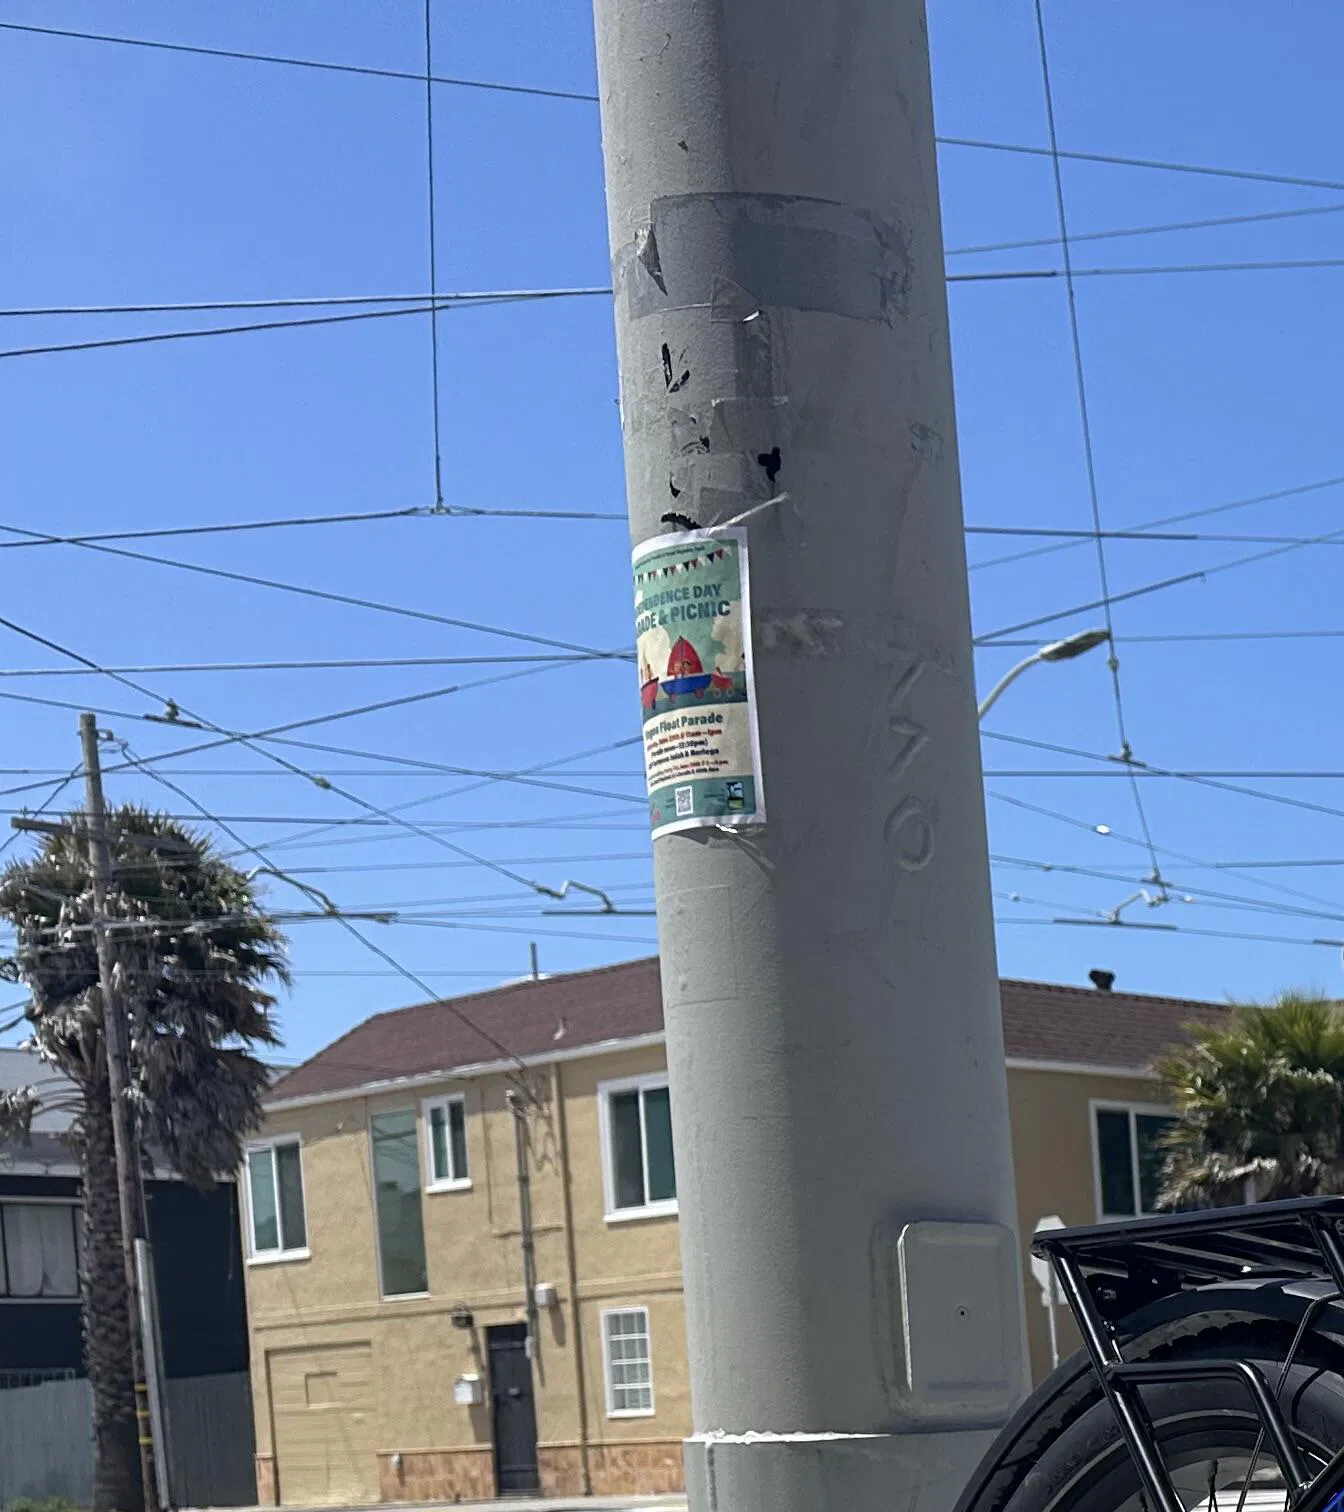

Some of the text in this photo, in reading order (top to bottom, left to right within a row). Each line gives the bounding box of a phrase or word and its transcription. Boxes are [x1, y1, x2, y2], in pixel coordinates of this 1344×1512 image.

[692, 583, 721, 599] DAY
[670, 600, 731, 622] PICNIC
[681, 712, 723, 727] Parade
